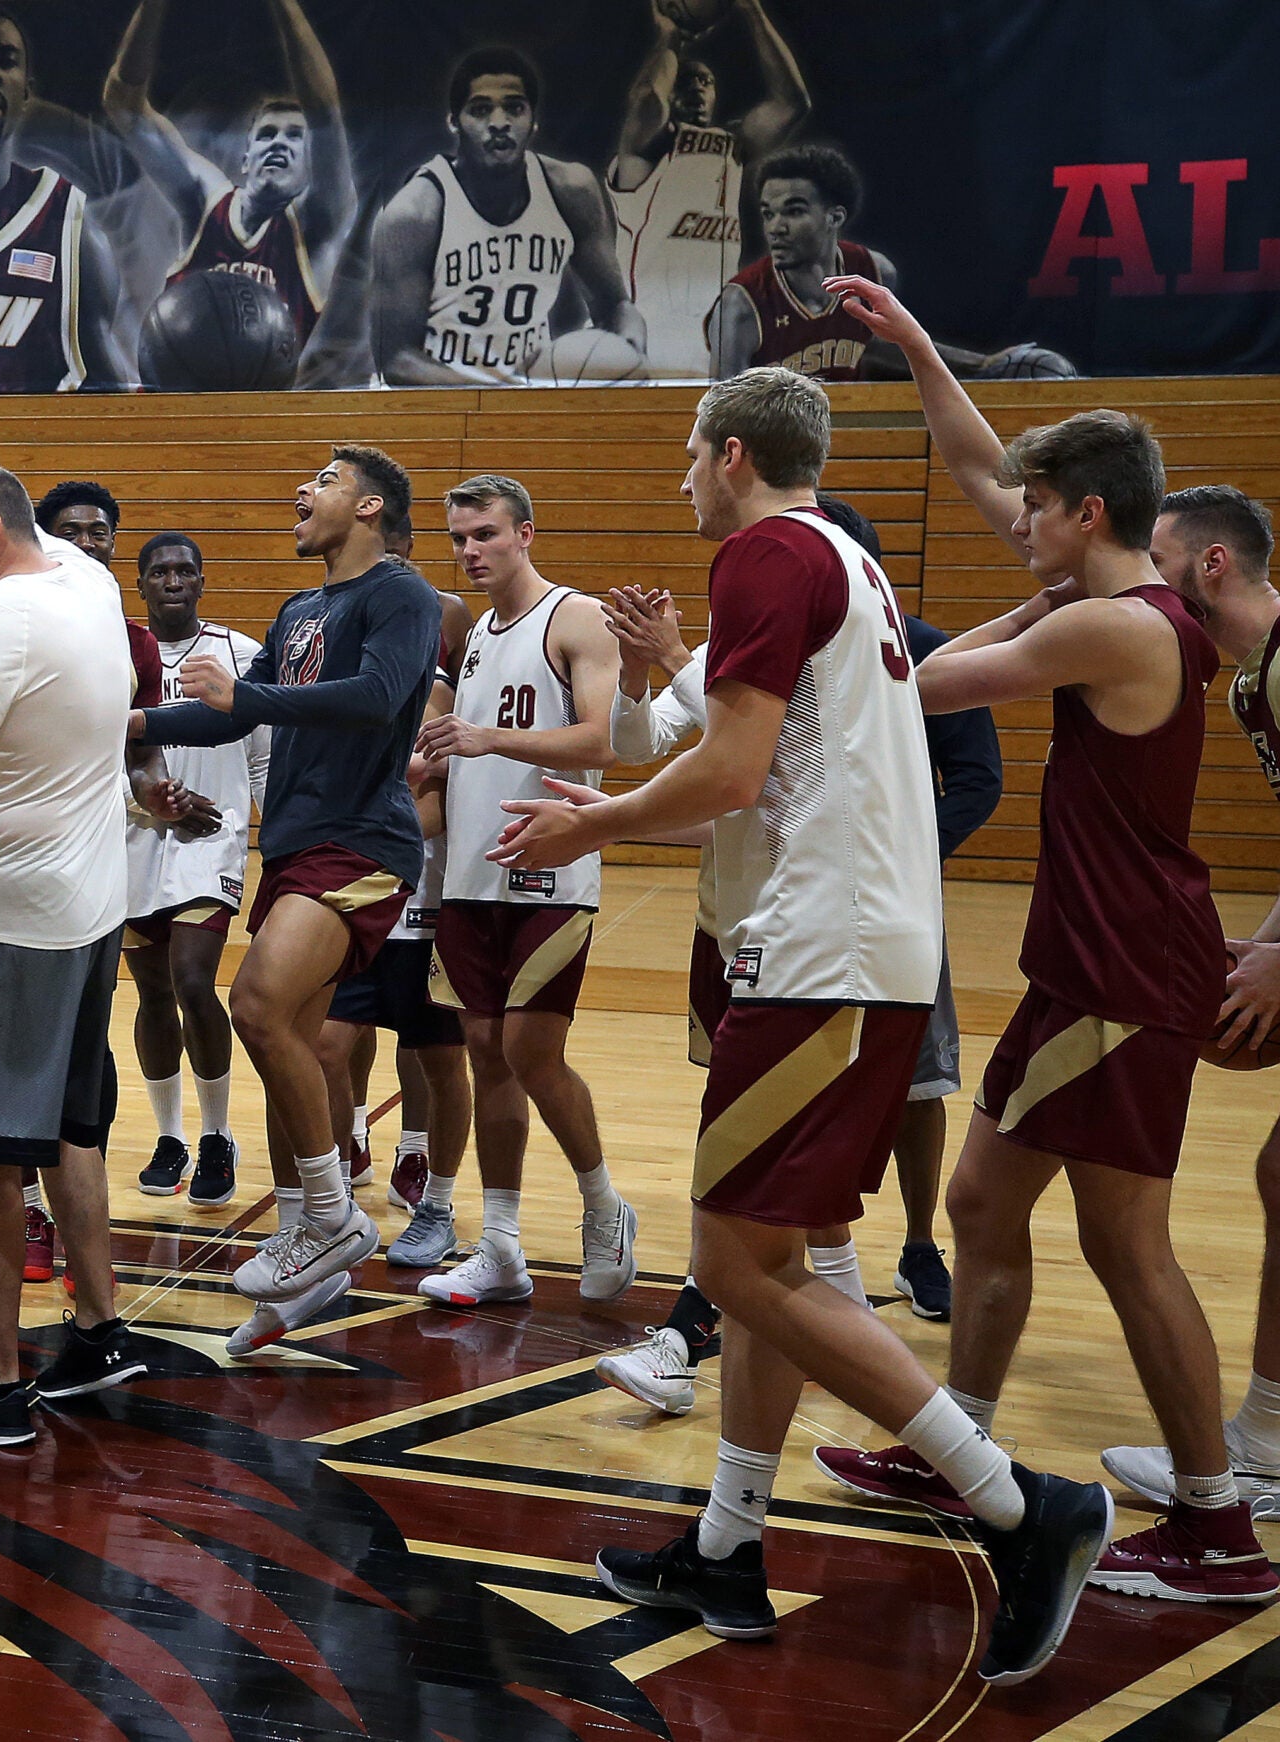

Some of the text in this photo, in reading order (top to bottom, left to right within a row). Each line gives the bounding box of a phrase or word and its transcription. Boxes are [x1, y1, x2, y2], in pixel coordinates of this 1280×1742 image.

[1027, 159, 1280, 297] AL
[444, 233, 565, 287] BOSTON
[458, 284, 537, 327] 30
[496, 683, 537, 730] 20
